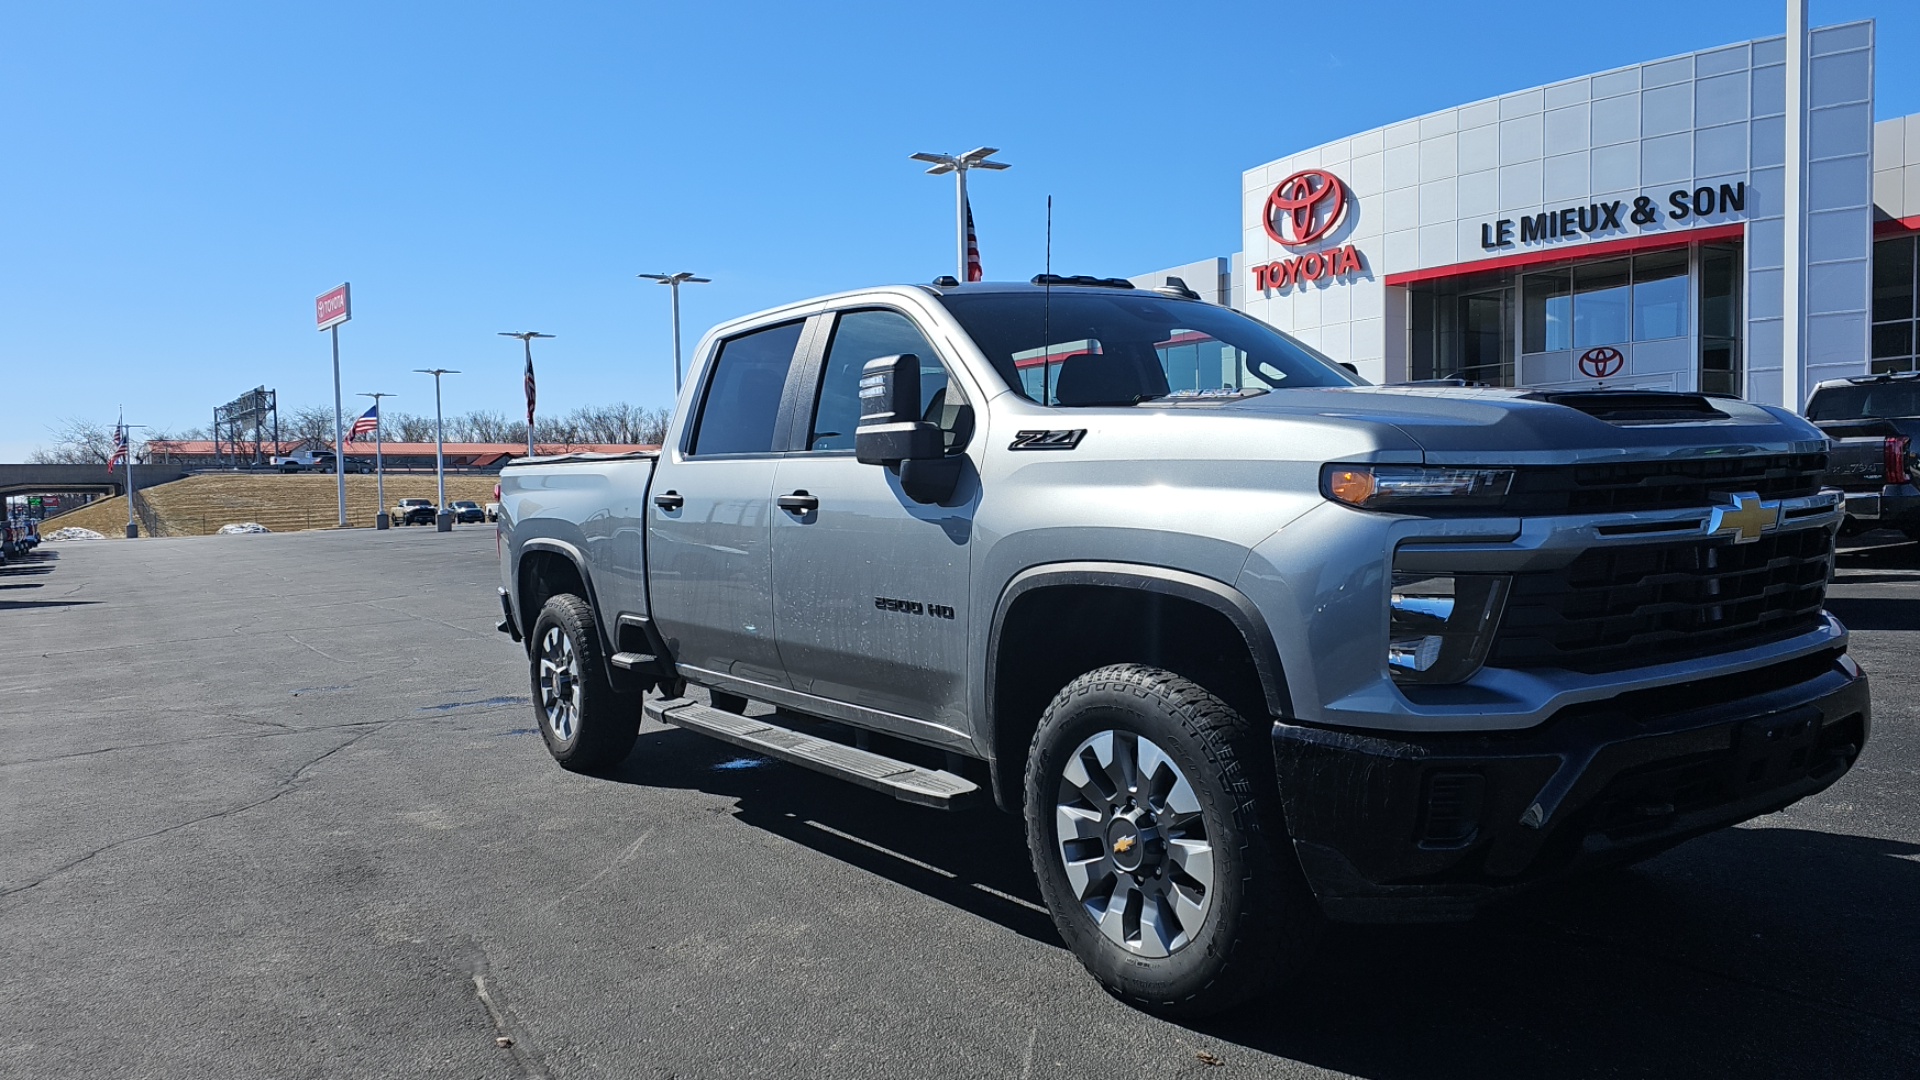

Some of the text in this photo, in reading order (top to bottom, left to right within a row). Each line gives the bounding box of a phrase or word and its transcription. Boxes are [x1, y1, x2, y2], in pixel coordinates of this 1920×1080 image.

[1481, 182, 1745, 249] LE MIEUX & SON
[1252, 244, 1362, 291] TOYOTA
[324, 294, 344, 314] TOYOTA
[1007, 428, 1088, 451] Z71
[874, 596, 955, 620] 2500 HD
